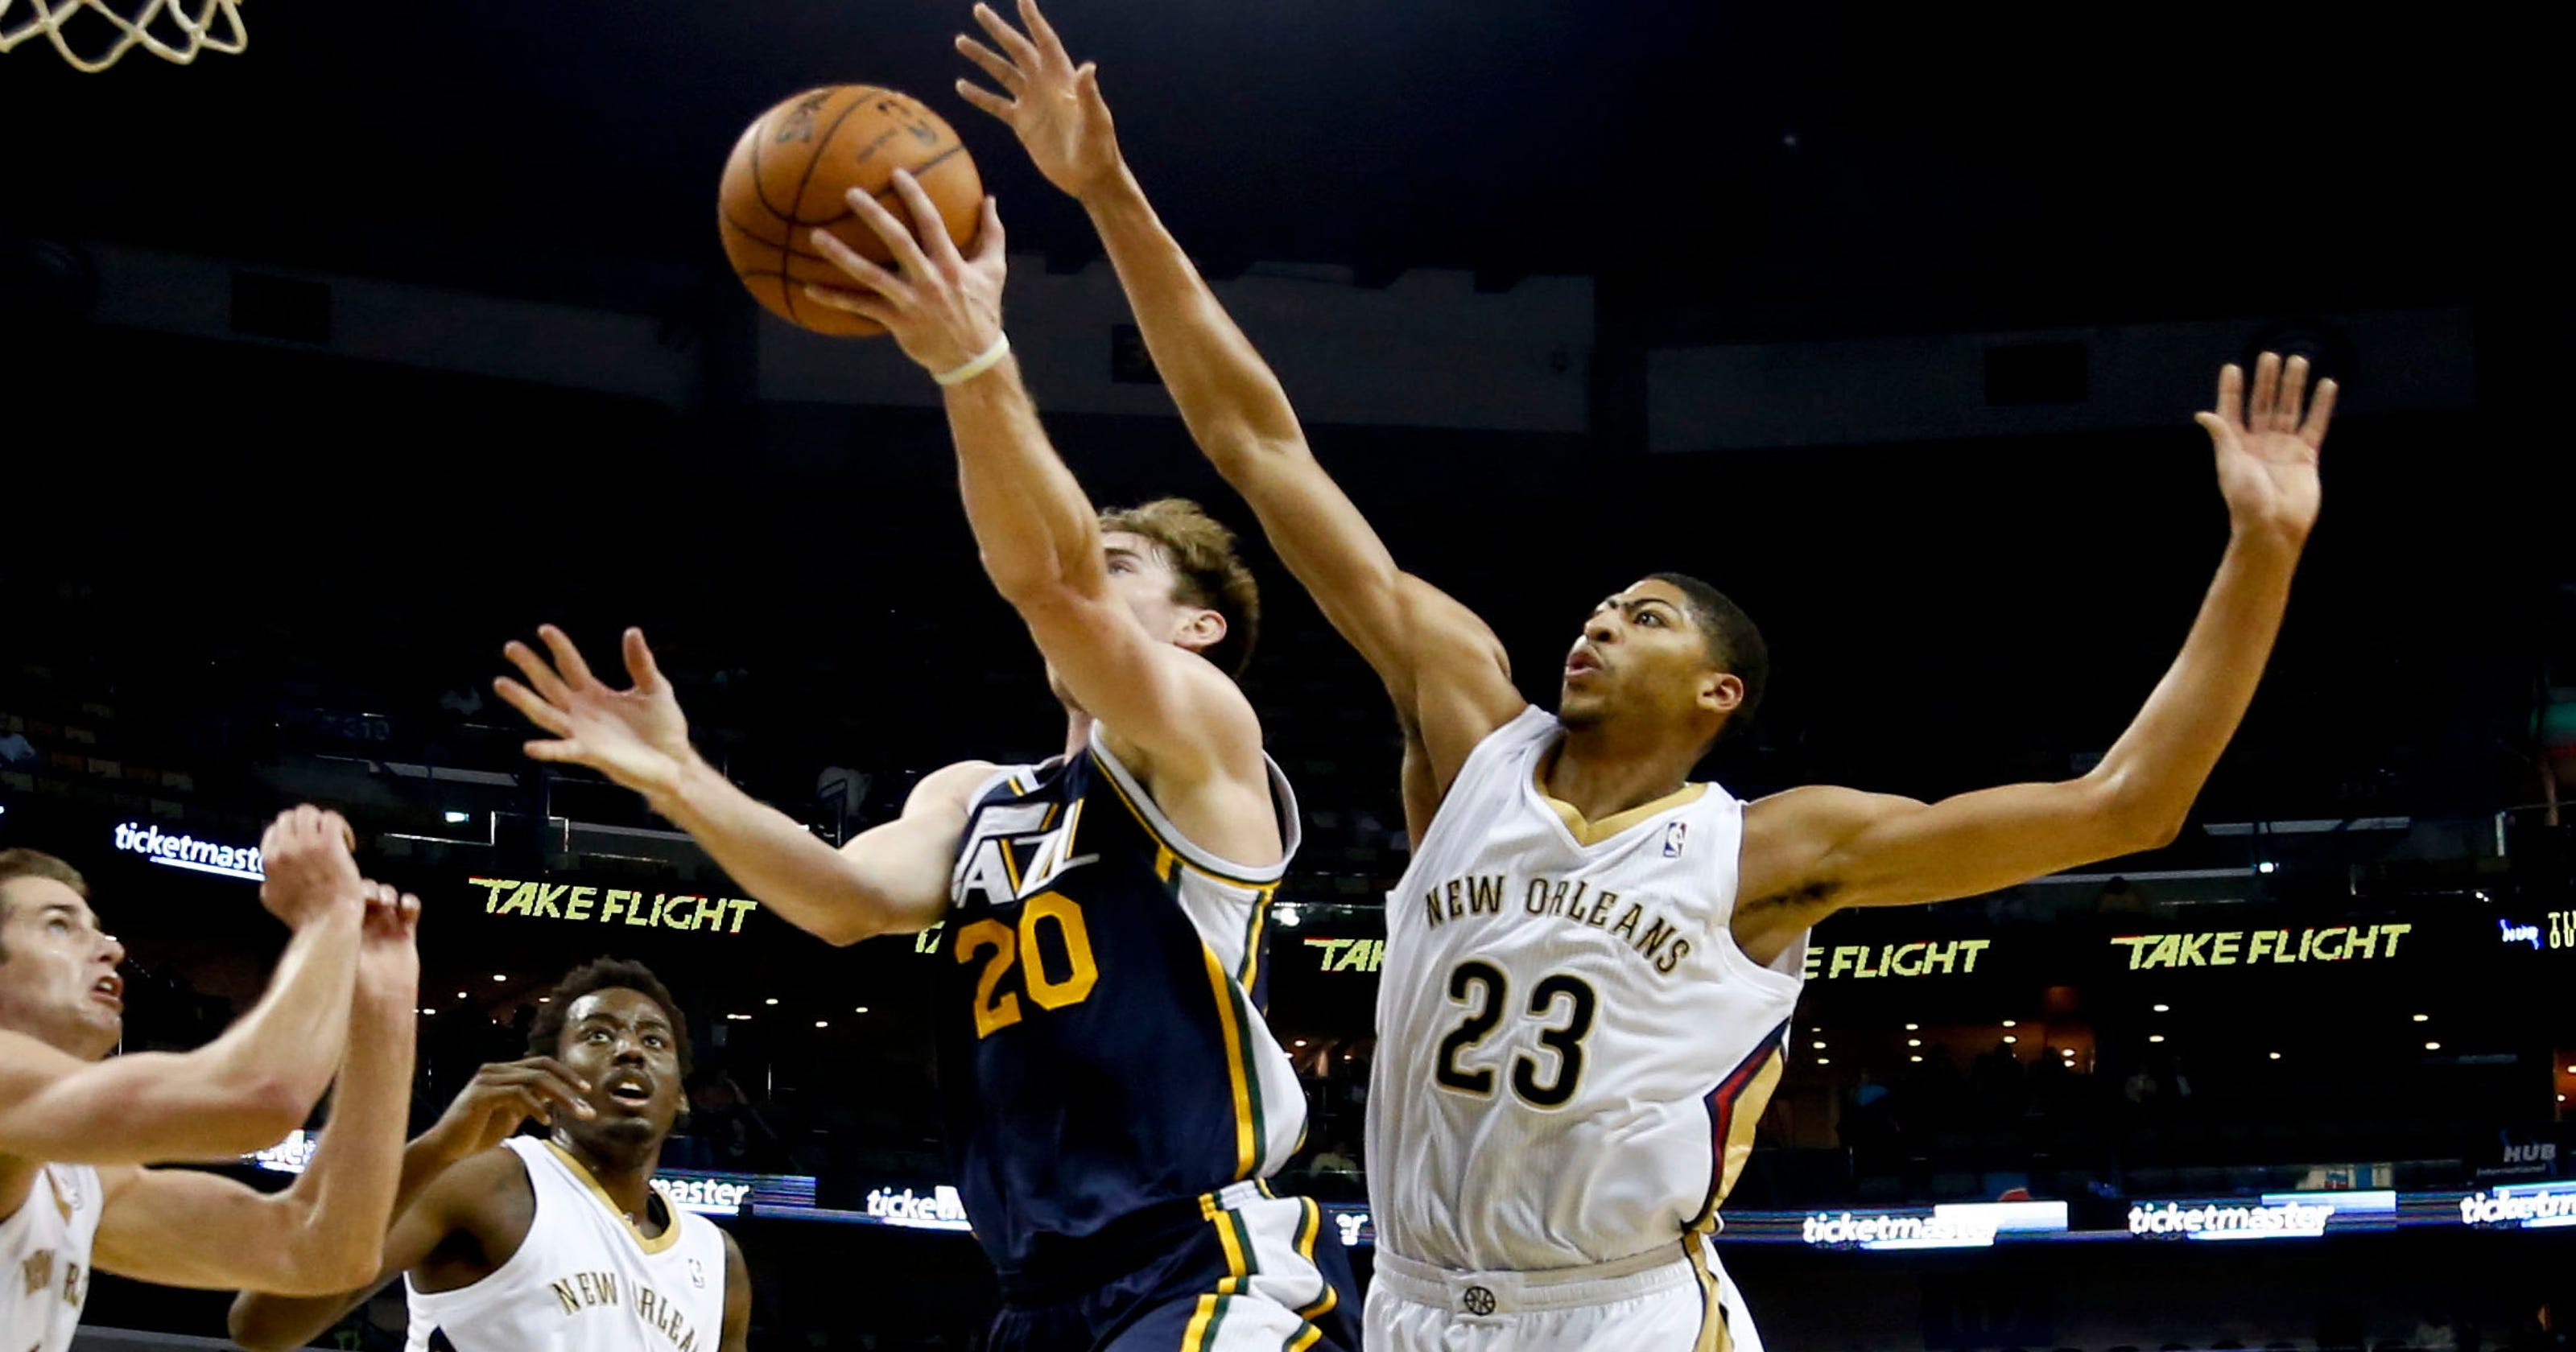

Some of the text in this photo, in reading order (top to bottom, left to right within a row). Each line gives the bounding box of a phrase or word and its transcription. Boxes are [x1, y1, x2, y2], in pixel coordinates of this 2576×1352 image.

[469, 876, 758, 934] TAKE FLIGHT
[1425, 874, 1690, 975] NEW ORLEANS
[953, 889, 1099, 1040] 20
[1828, 939, 1991, 979] FLIGHT
[2110, 923, 2412, 971] TAKE FLIGHT
[1435, 957, 1597, 1110] 23
[2502, 1143, 2557, 1163] HUB
[2128, 1202, 2335, 1235] ticketmaster
[550, 1271, 700, 1352] NEW RLEA
